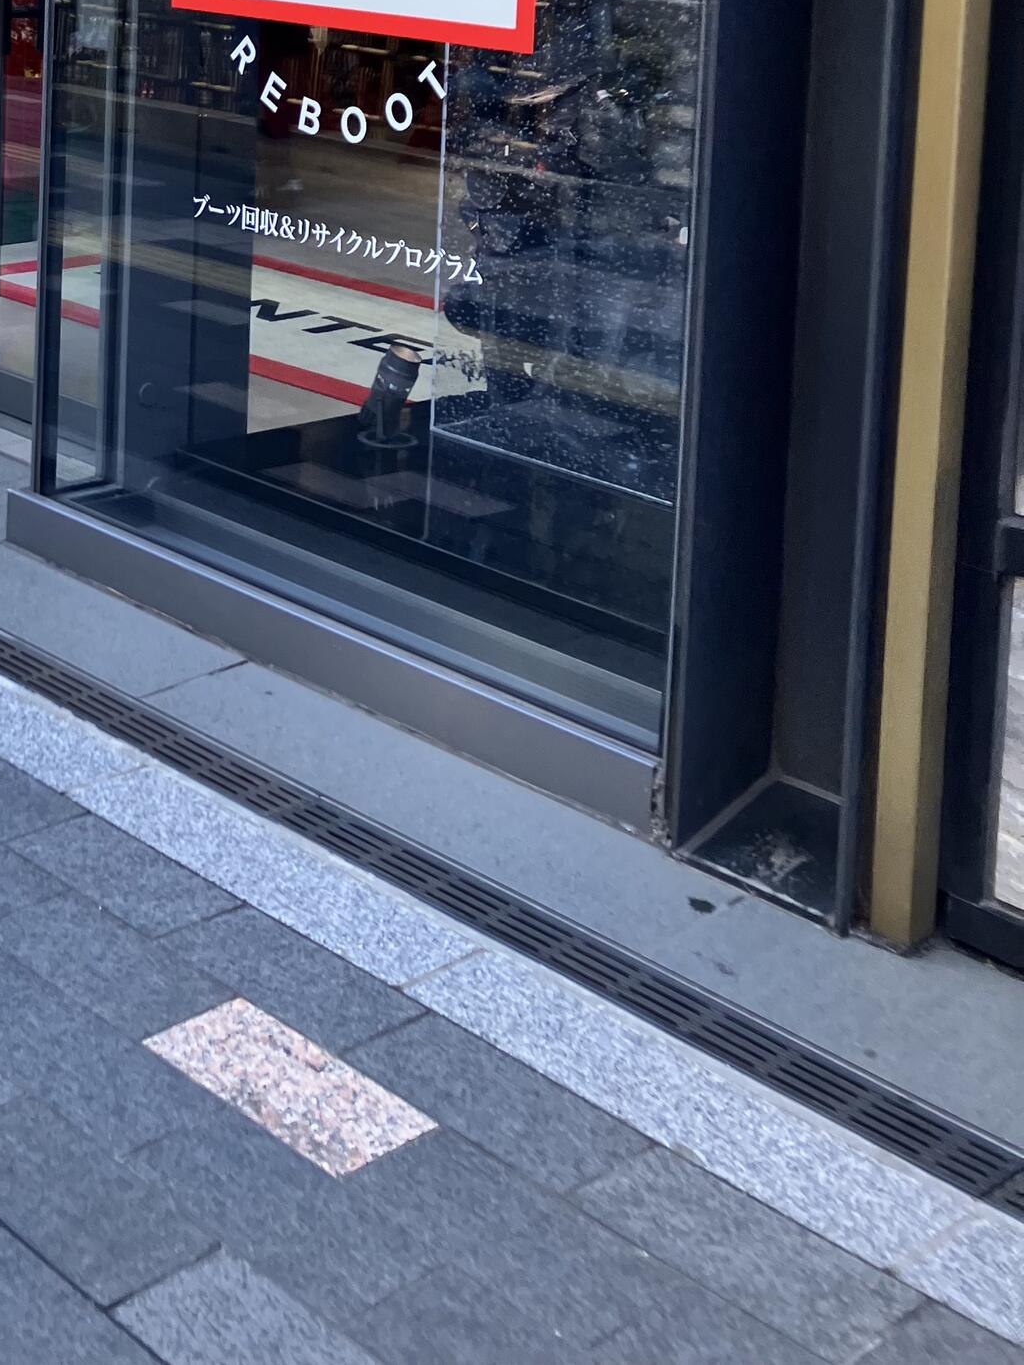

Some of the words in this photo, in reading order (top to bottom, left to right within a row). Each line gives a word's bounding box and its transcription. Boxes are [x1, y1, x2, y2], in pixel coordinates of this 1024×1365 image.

[230, 35, 447, 144] REBOOT
[192, 194, 484, 284] ブーツ回収&リサイクルプログラム
